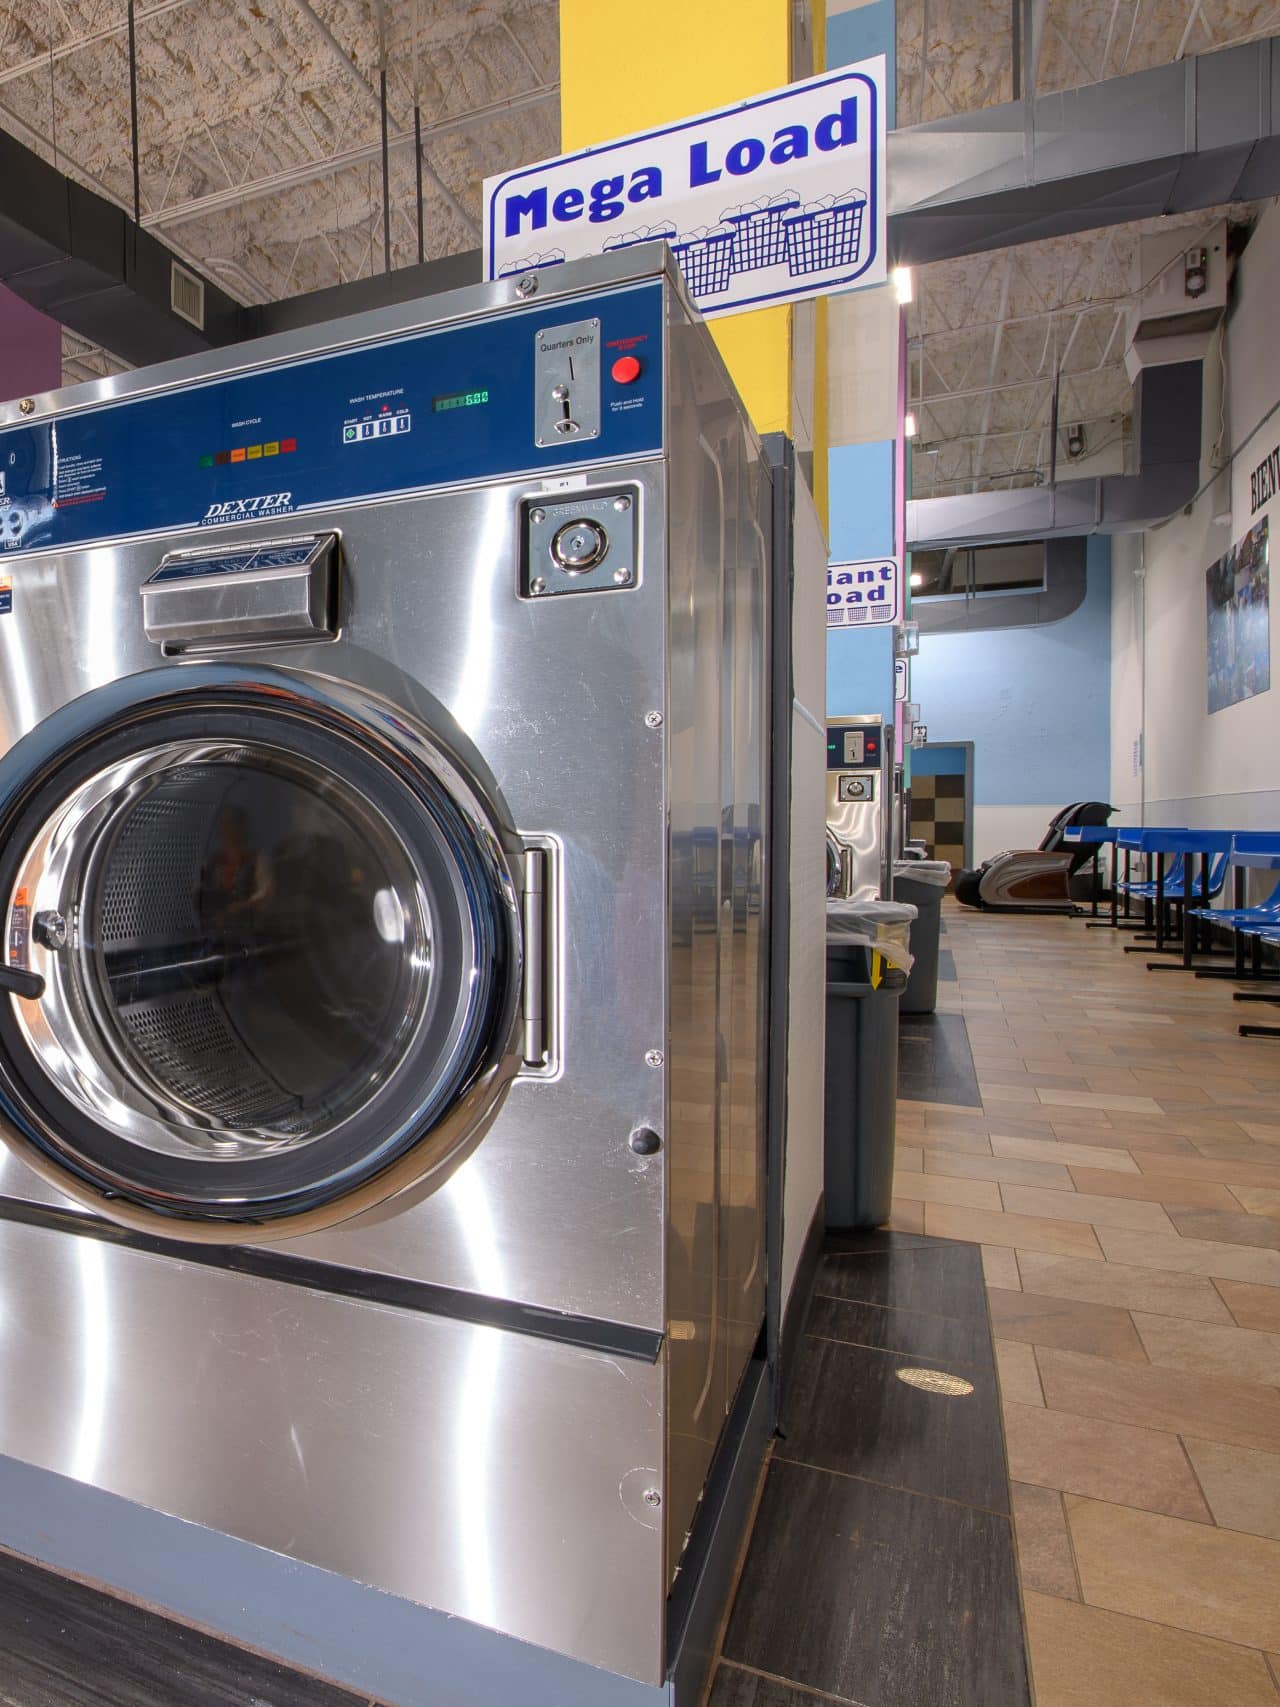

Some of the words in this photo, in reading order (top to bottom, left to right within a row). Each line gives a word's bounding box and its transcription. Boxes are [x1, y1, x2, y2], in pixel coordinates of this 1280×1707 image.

[505, 166, 662, 237] Mega
[690, 96, 858, 188] Load
[540, 339, 574, 352] Quarters
[576, 336, 594, 345] Only
[204, 492, 292, 518] DEXTER
[202, 511, 256, 525] COMMERCIAL
[258, 506, 294, 516] WASHER
[827, 566, 892, 586] iant
[827, 585, 885, 604] oad
